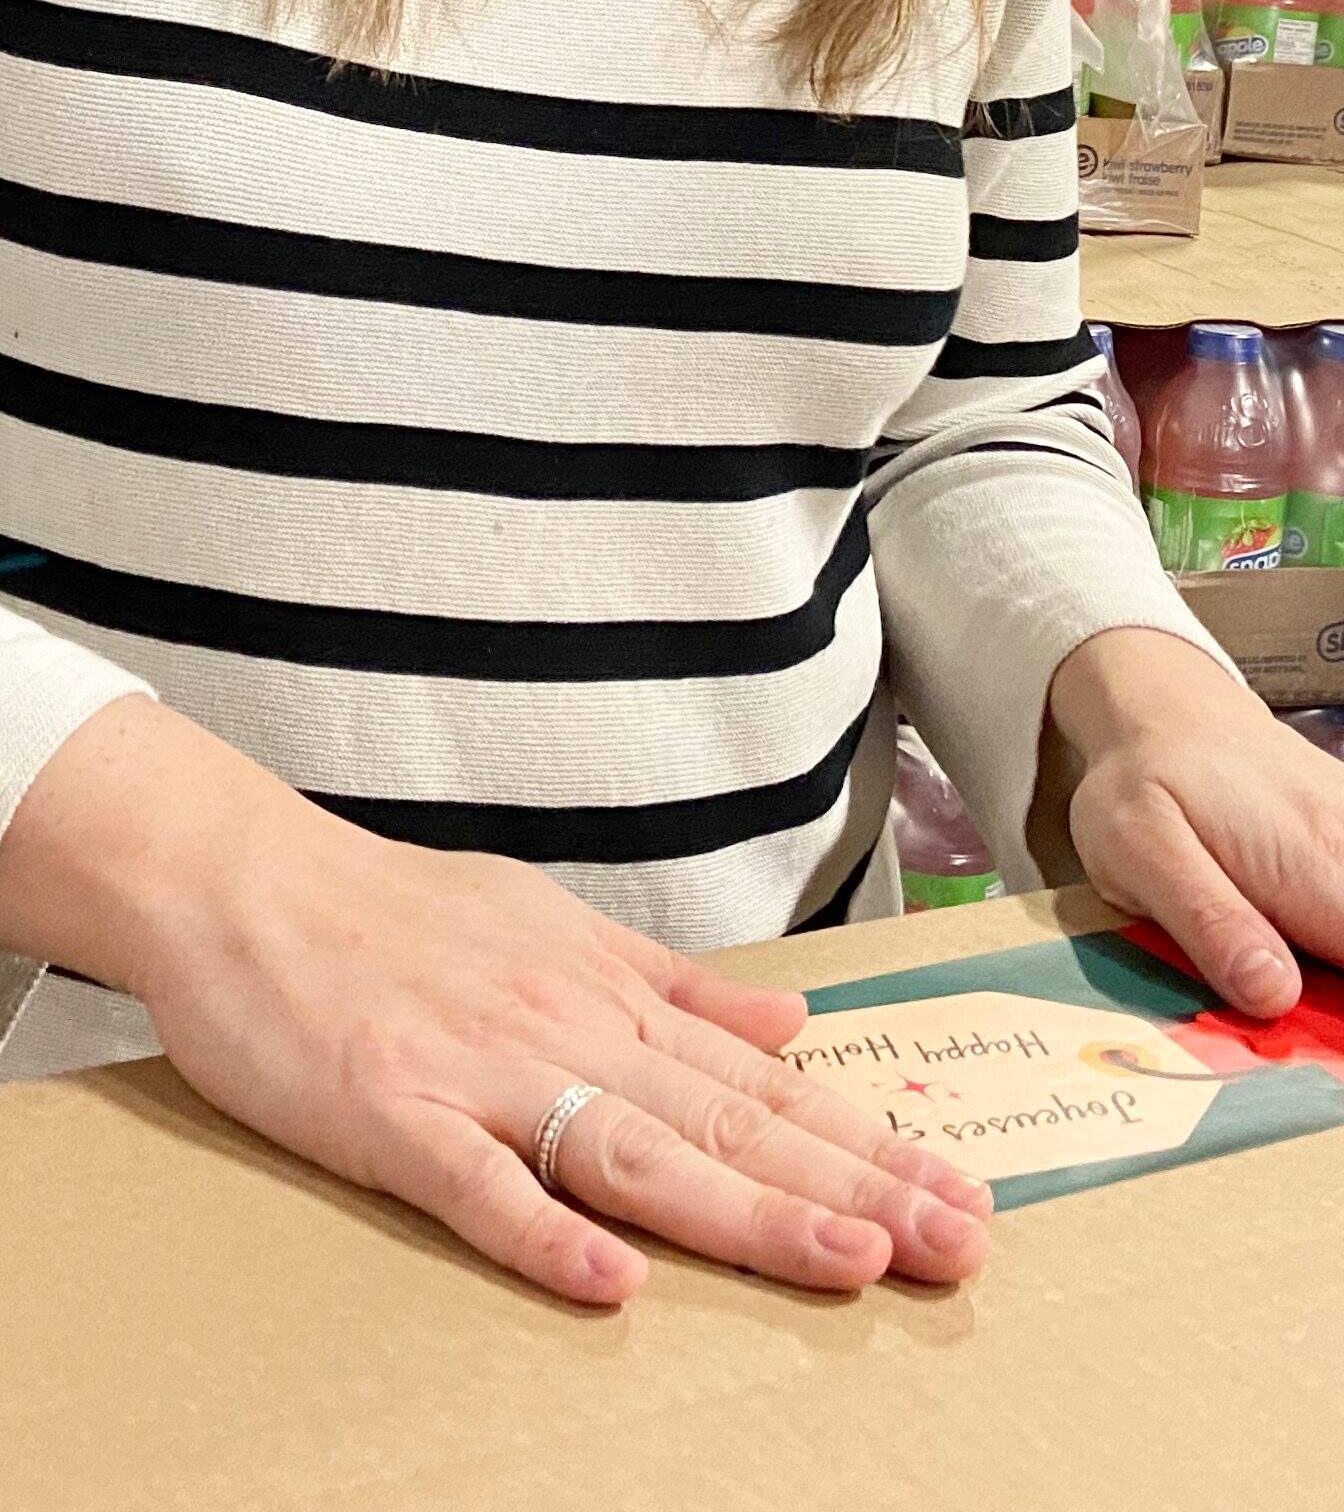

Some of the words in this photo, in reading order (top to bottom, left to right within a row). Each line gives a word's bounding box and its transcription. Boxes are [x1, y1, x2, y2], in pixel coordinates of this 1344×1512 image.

[1129, 159, 1194, 177] strawberry
[770, 1033, 900, 1073] Holid
[913, 1029, 1051, 1065] Happy
[941, 1090, 1144, 1141] Joyeuses
